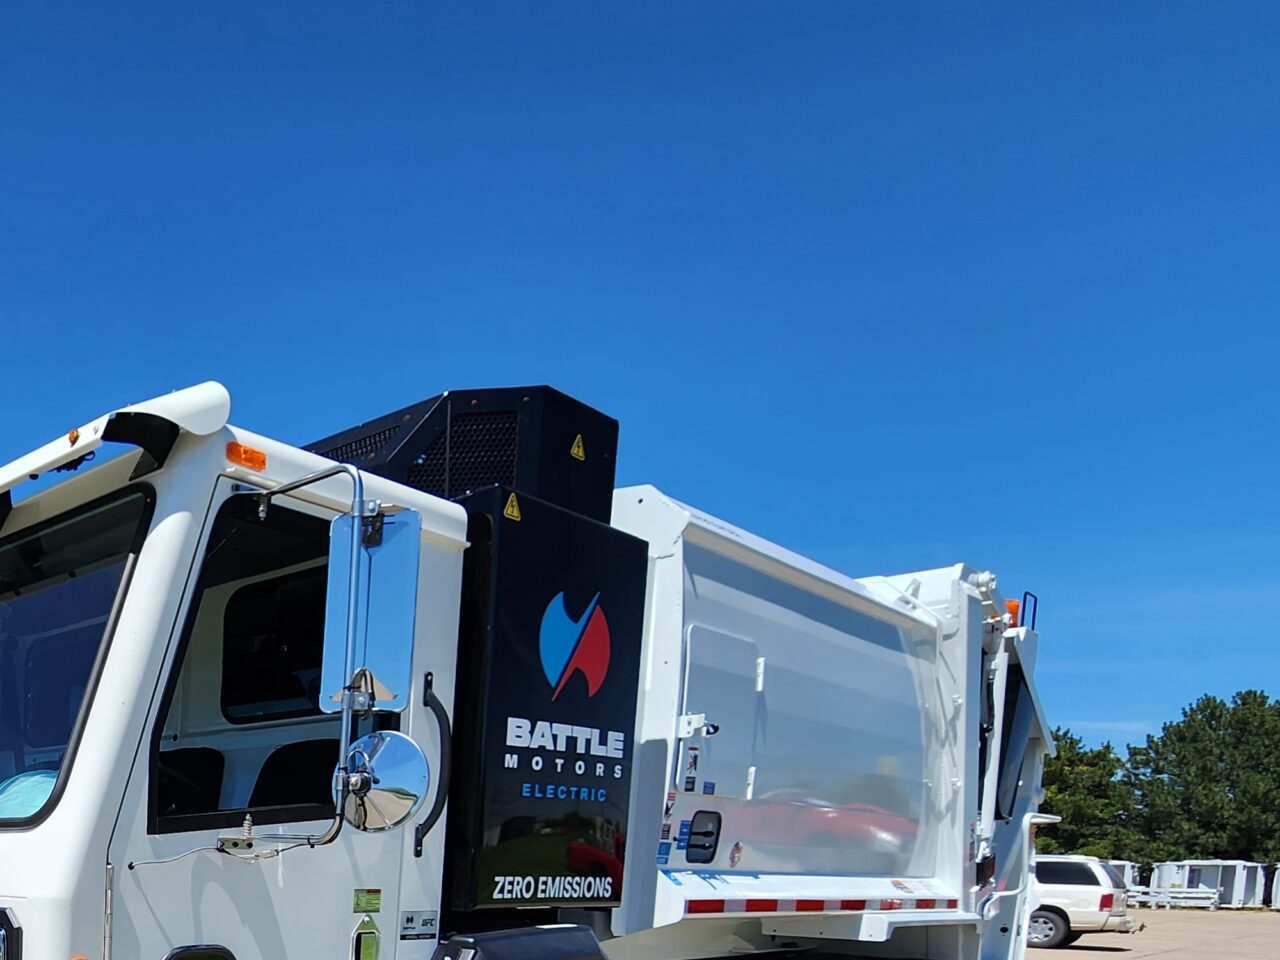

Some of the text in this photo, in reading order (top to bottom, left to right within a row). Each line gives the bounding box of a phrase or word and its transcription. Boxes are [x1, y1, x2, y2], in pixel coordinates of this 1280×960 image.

[506, 717, 624, 758] BATTLE
[504, 753, 623, 779] MOTORS
[522, 783, 608, 801] ELECTRIC
[492, 876, 613, 899] ZERO EMISSIONS
